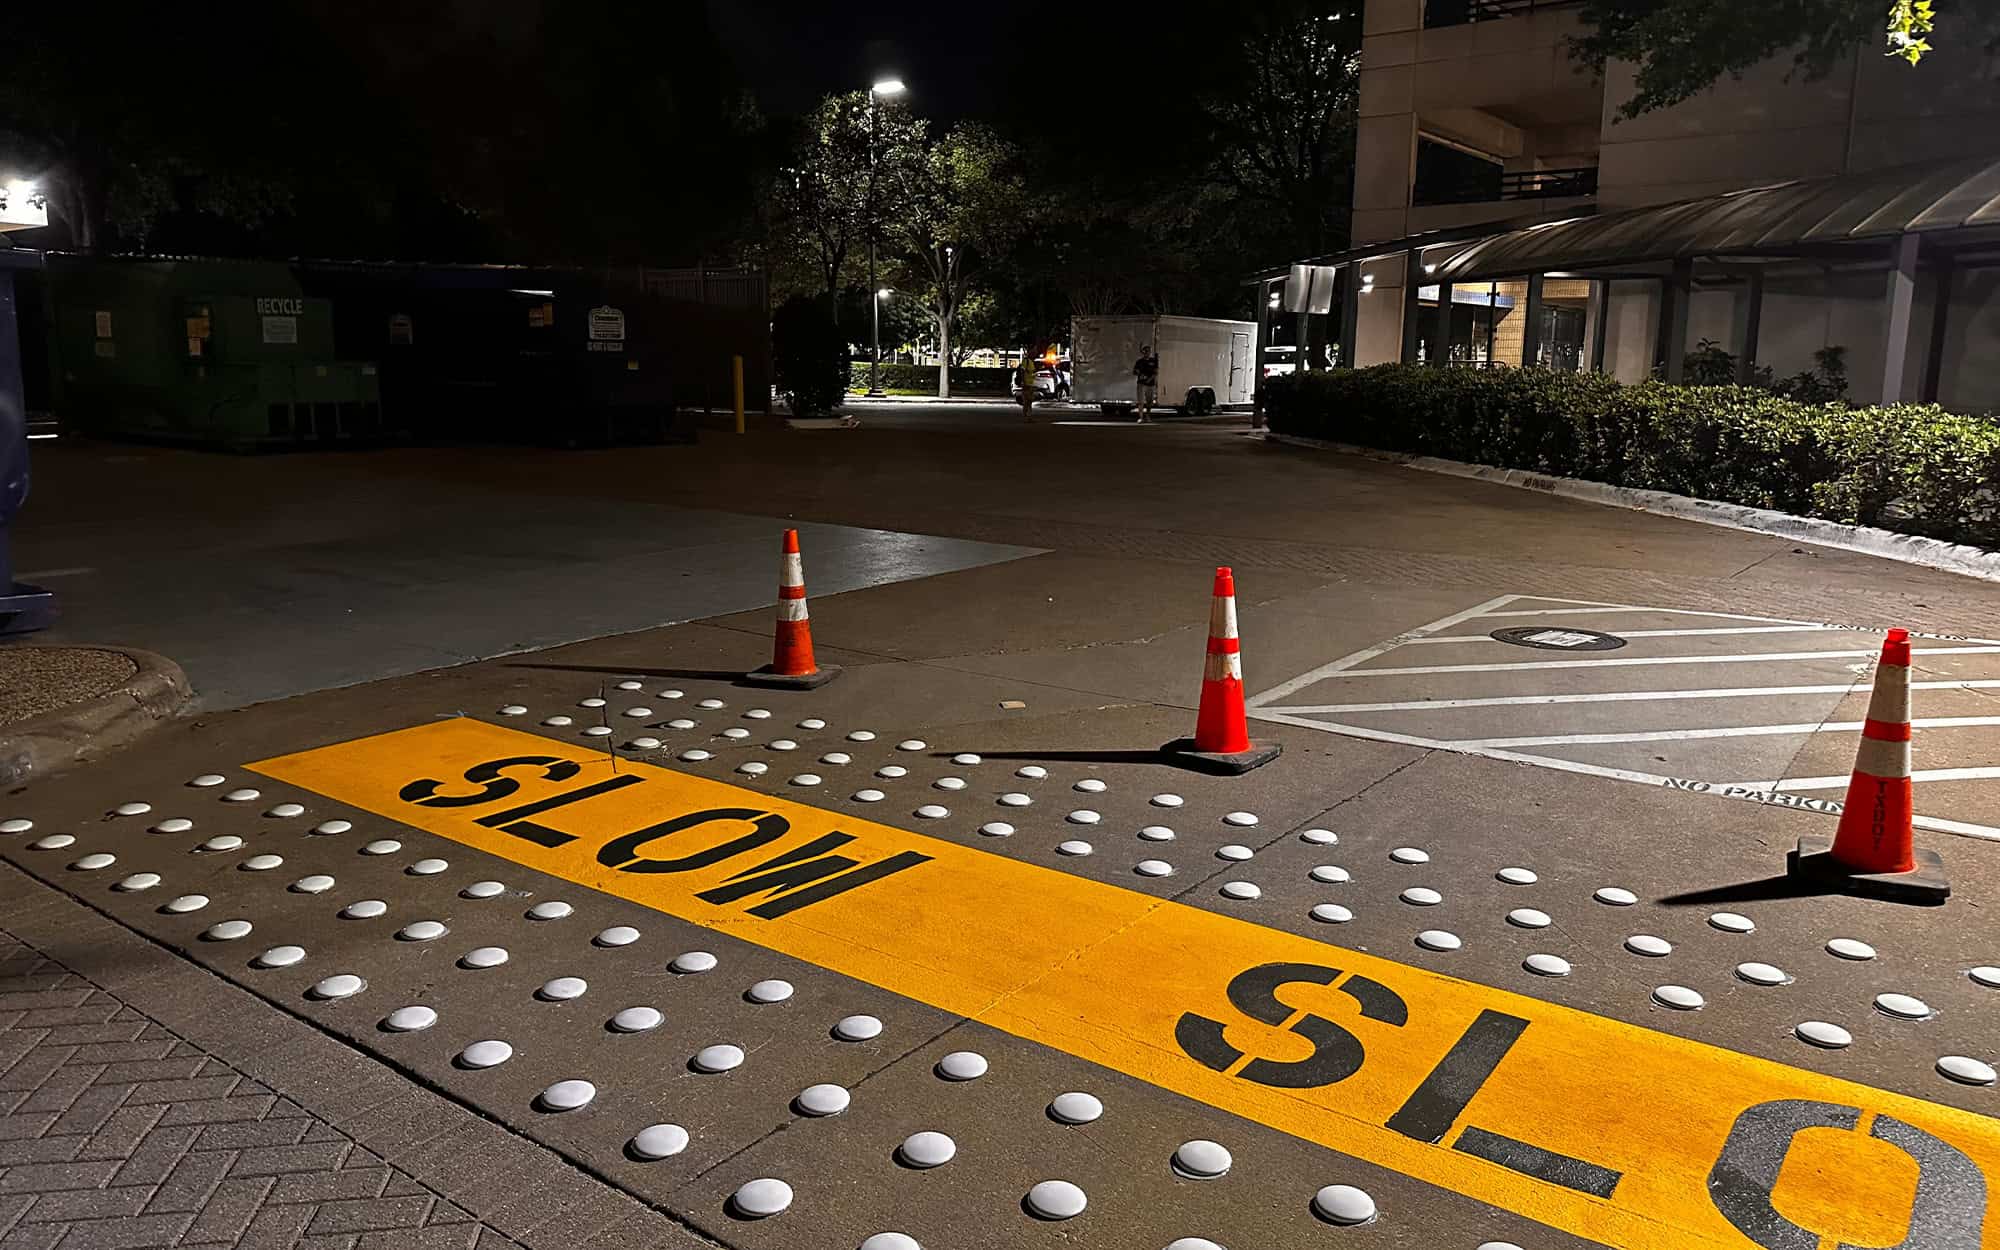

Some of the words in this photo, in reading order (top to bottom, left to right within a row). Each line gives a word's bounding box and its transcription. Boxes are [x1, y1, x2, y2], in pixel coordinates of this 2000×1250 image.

[256, 298, 304, 315] RECYCLE
[399, 755, 936, 920] SLOW
[1662, 776, 1711, 793] NO
[1722, 787, 1844, 812] PARKIN
[1174, 962, 1987, 1250] SLO
